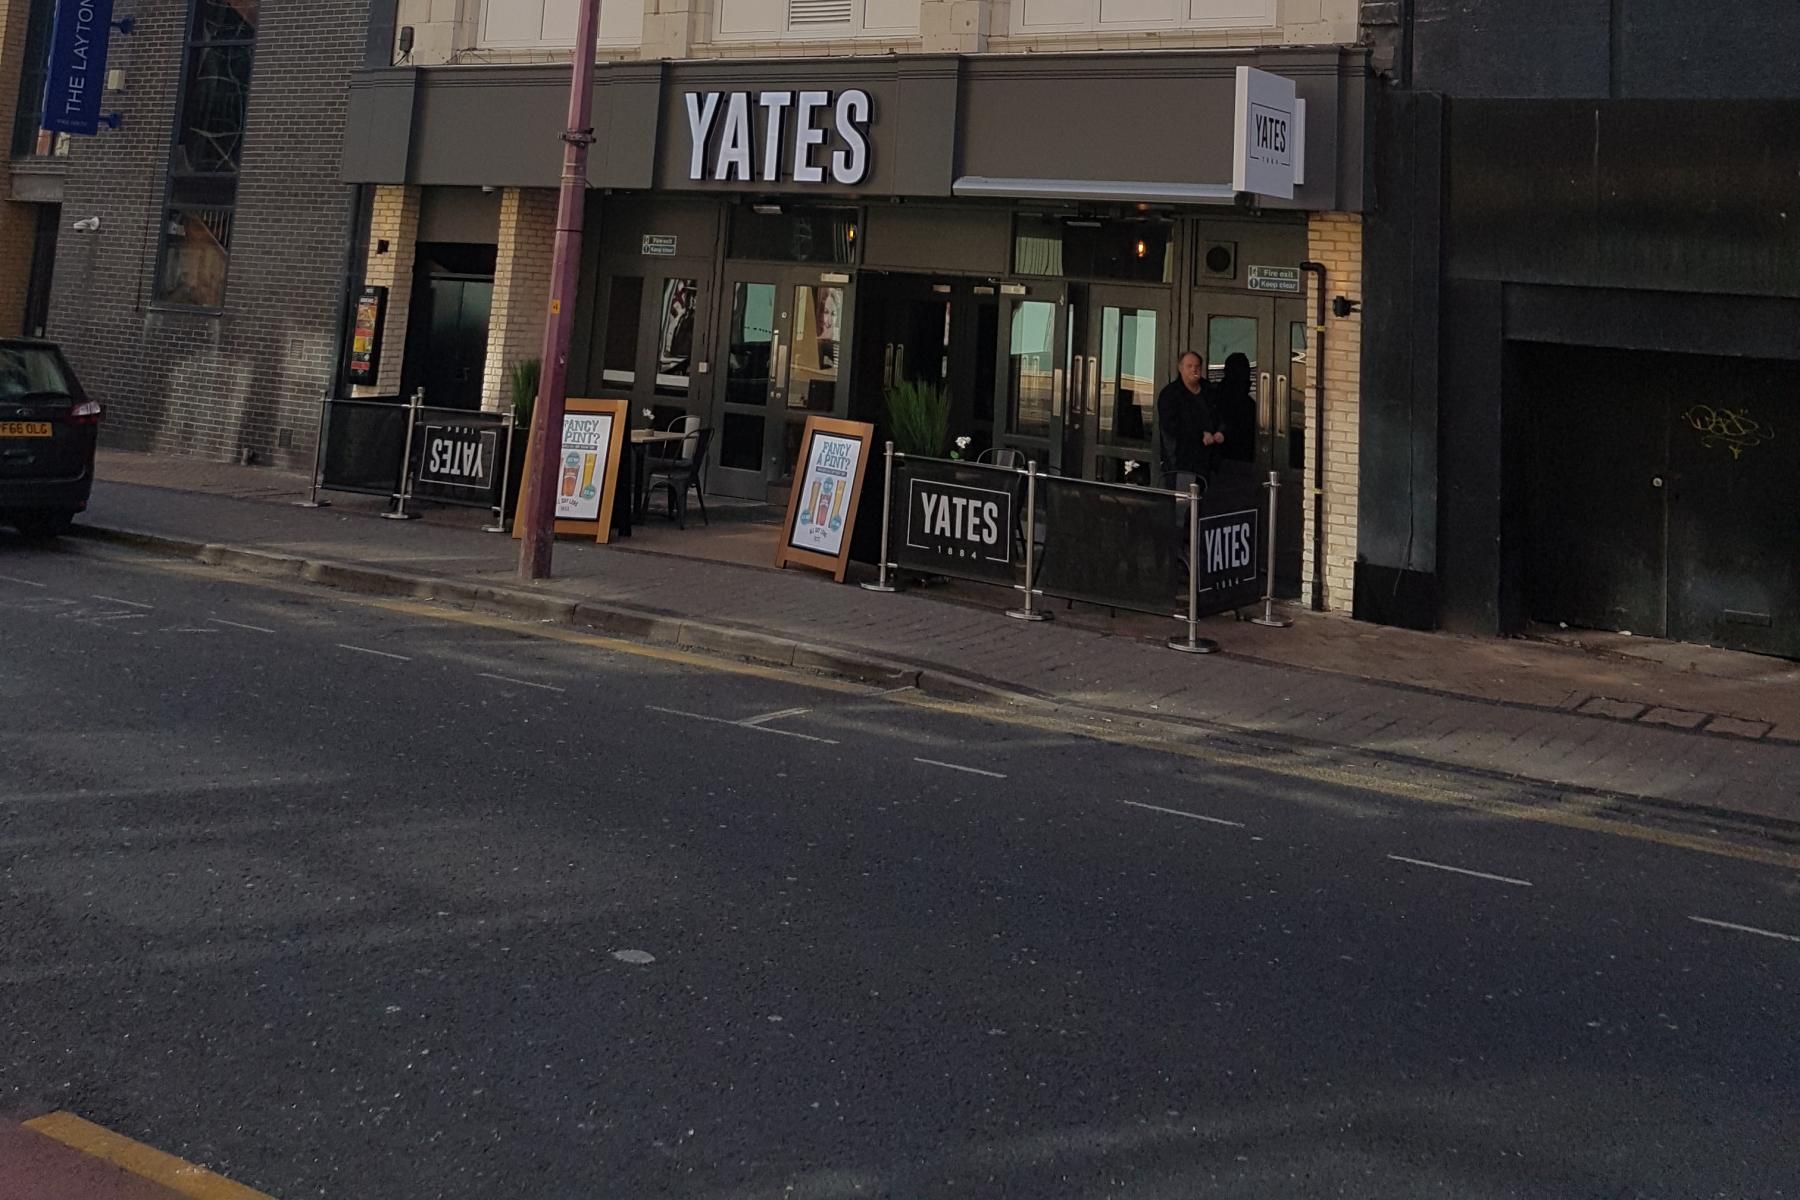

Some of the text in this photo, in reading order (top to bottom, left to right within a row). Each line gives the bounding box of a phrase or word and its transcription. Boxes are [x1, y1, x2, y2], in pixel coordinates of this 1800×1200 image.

[65, 76, 85, 114] THE
[684, 88, 873, 185] YATES
[1256, 113, 1286, 153] YATES
[1263, 269, 1279, 277] Fire
[1260, 280, 1297, 289] Keep clear
[0, 422, 24, 434] F66
[564, 431, 601, 444] PINT?
[429, 438, 483, 478] YATES
[822, 441, 852, 457] FANCY
[816, 453, 851, 471] A PINT?
[921, 492, 998, 544] YATES
[938, 545, 977, 559] 1884
[1204, 522, 1250, 574] YATES
